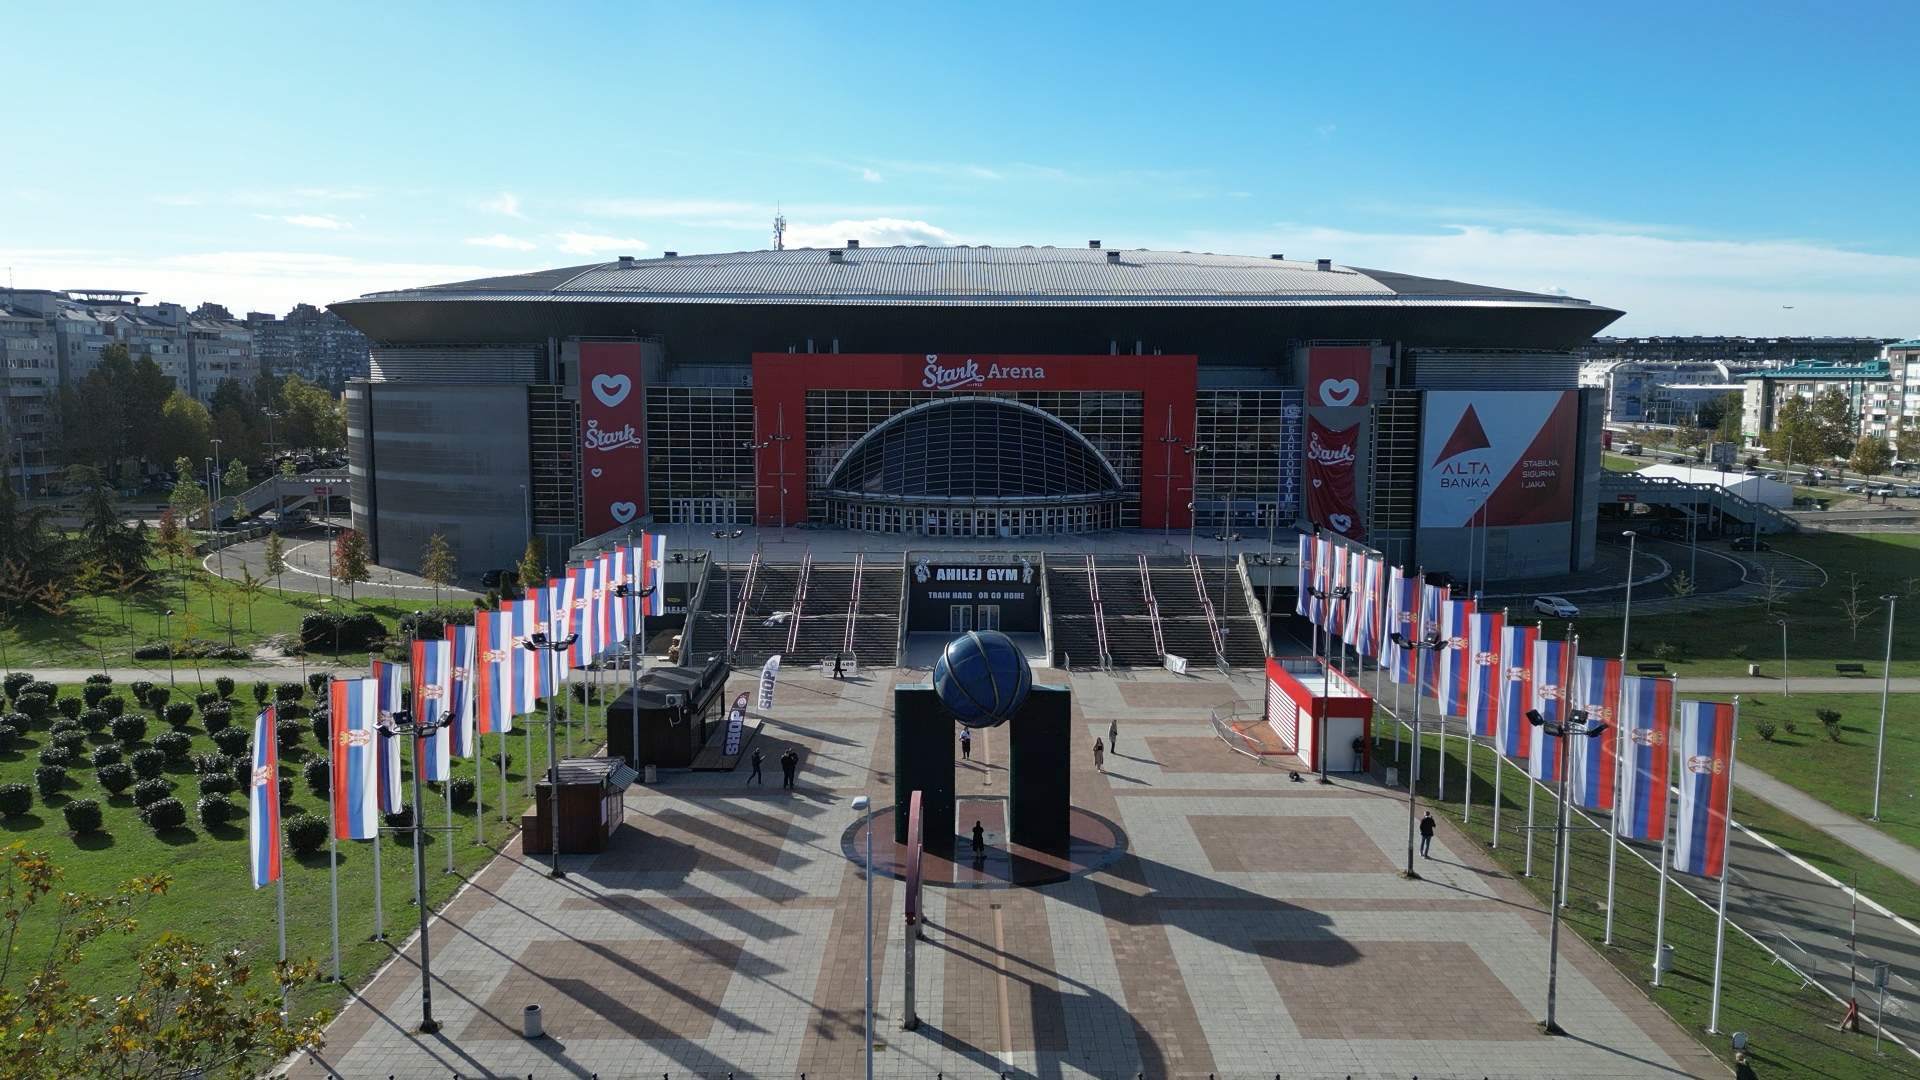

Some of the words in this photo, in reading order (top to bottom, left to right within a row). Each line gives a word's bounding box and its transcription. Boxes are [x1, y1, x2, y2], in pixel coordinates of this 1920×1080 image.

[987, 364, 1045, 379] Arena
[1442, 462, 1491, 475] ALTA
[1522, 460, 1559, 468] STABILNA,
[1522, 470, 1556, 478] SIGURNA
[1440, 478, 1490, 488] BANKA
[1525, 481, 1546, 489] JAKA
[936, 568, 982, 581] AHILEJ
[986, 568, 1018, 581] GYM
[928, 591, 951, 599] TRAIN
[952, 591, 973, 599] HARD
[978, 591, 989, 600] OR
[990, 592, 1002, 600] GO
[1003, 592, 1025, 600] HOME
[759, 670, 776, 710] SHOP
[725, 710, 744, 755] SHOP
